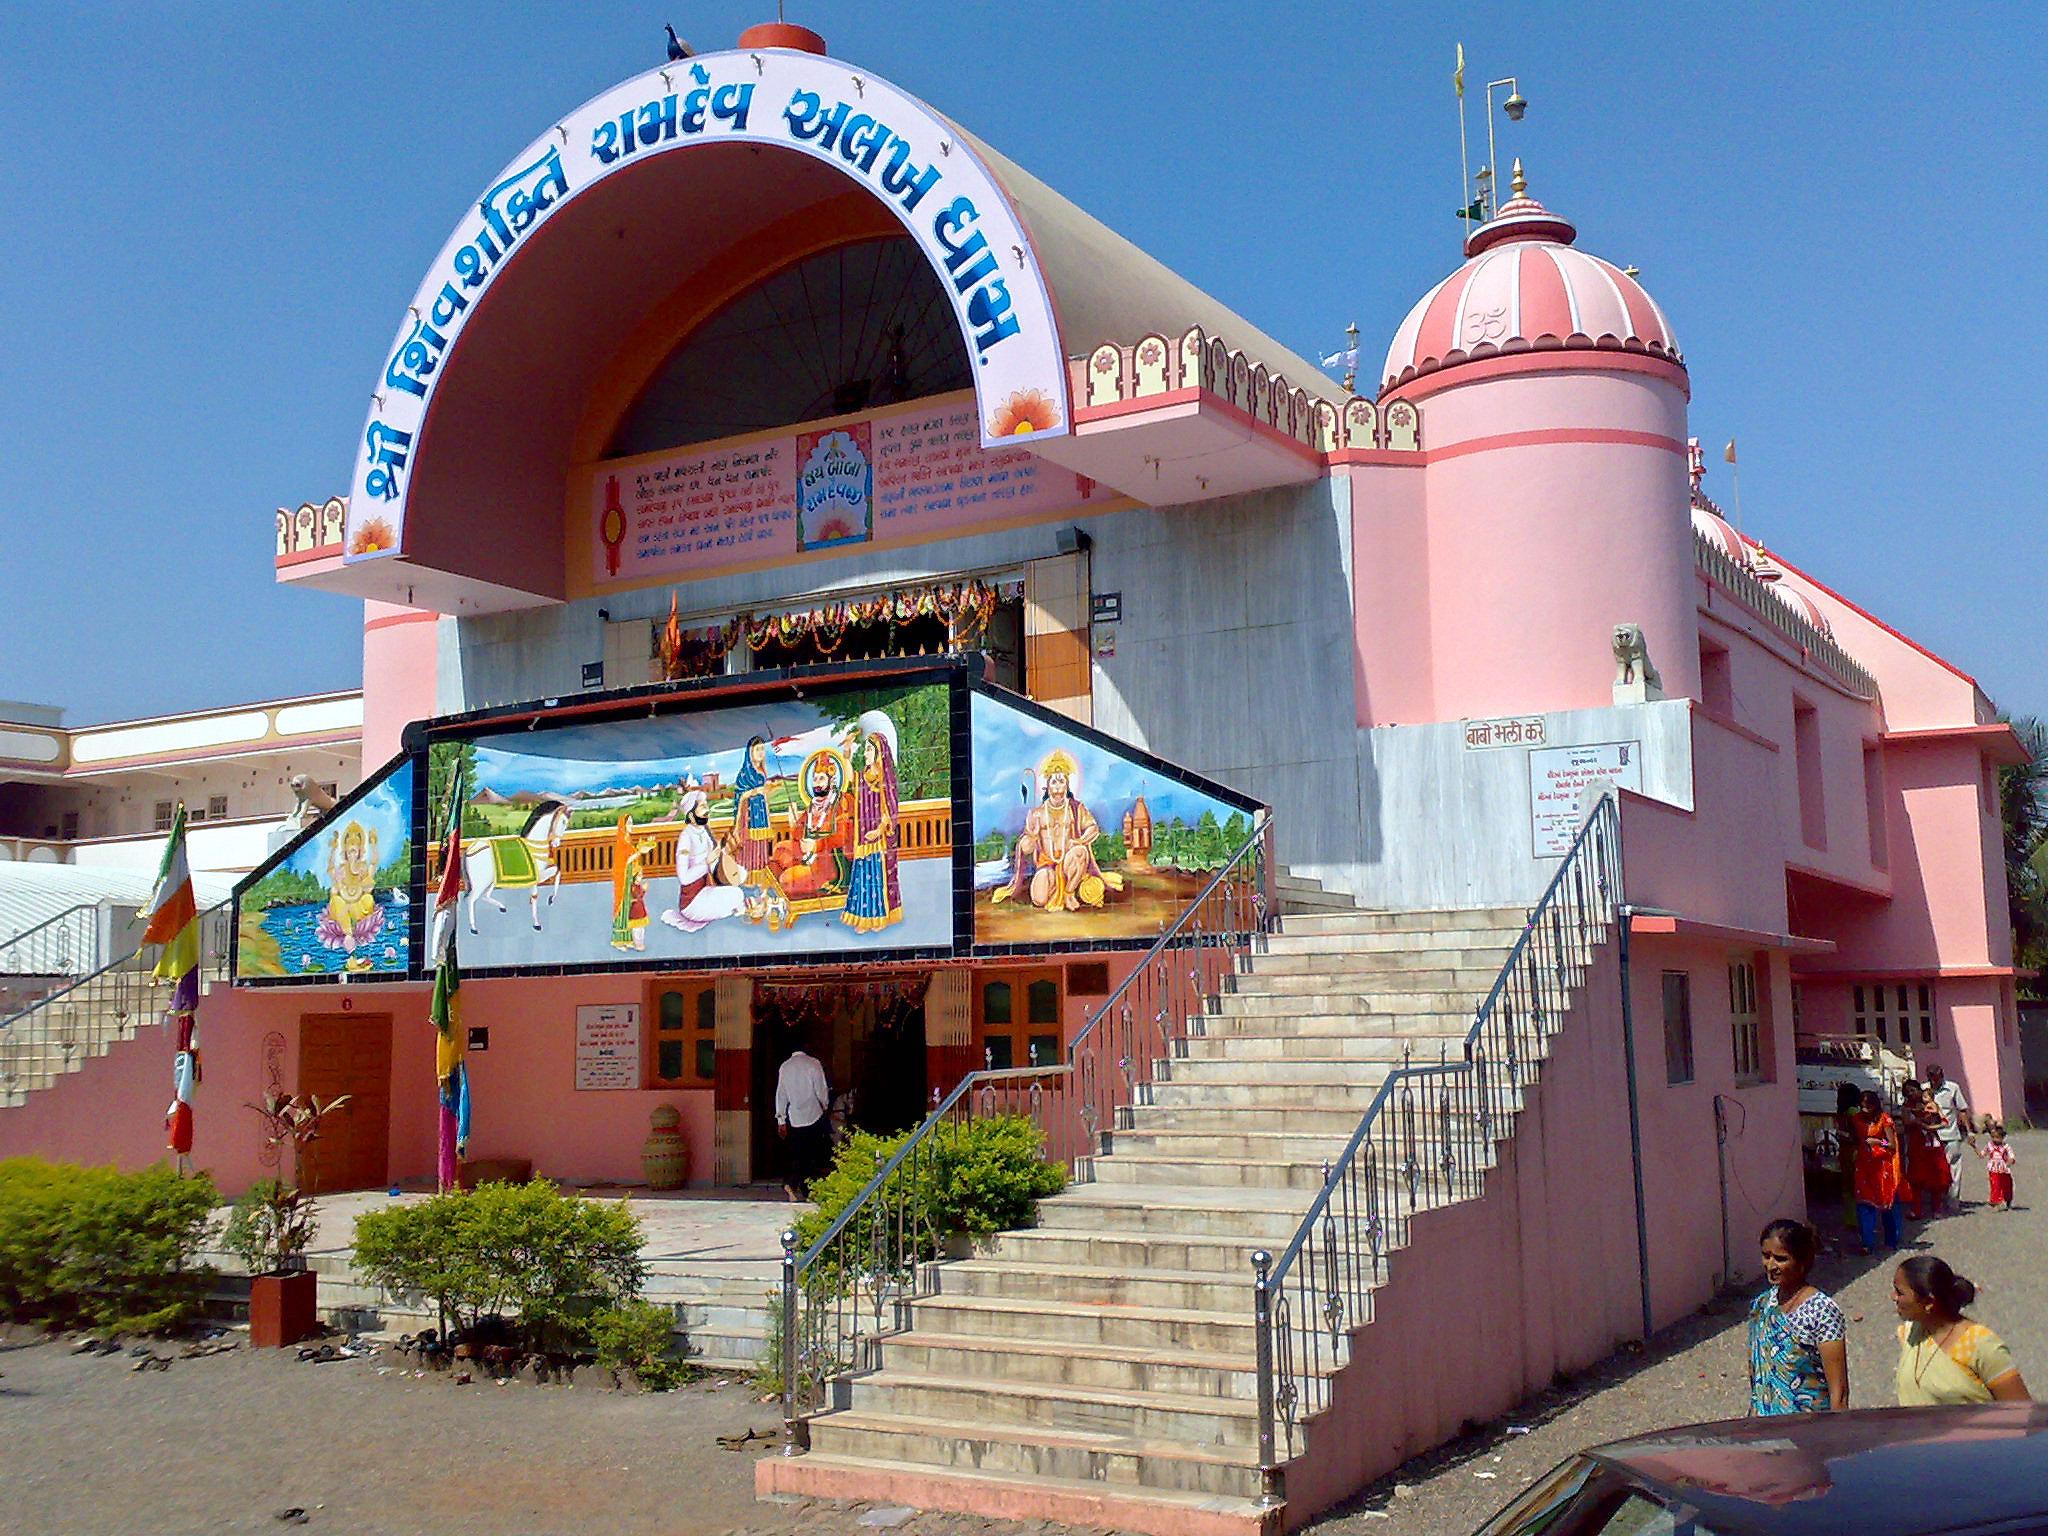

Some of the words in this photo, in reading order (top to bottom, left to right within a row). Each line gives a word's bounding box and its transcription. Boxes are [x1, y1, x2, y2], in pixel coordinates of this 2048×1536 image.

[366, 420, 413, 502] શ્રી
[592, 63, 756, 164] રામદેવ
[783, 88, 943, 214] અલખ
[1467, 723, 1492, 745] बाबो
